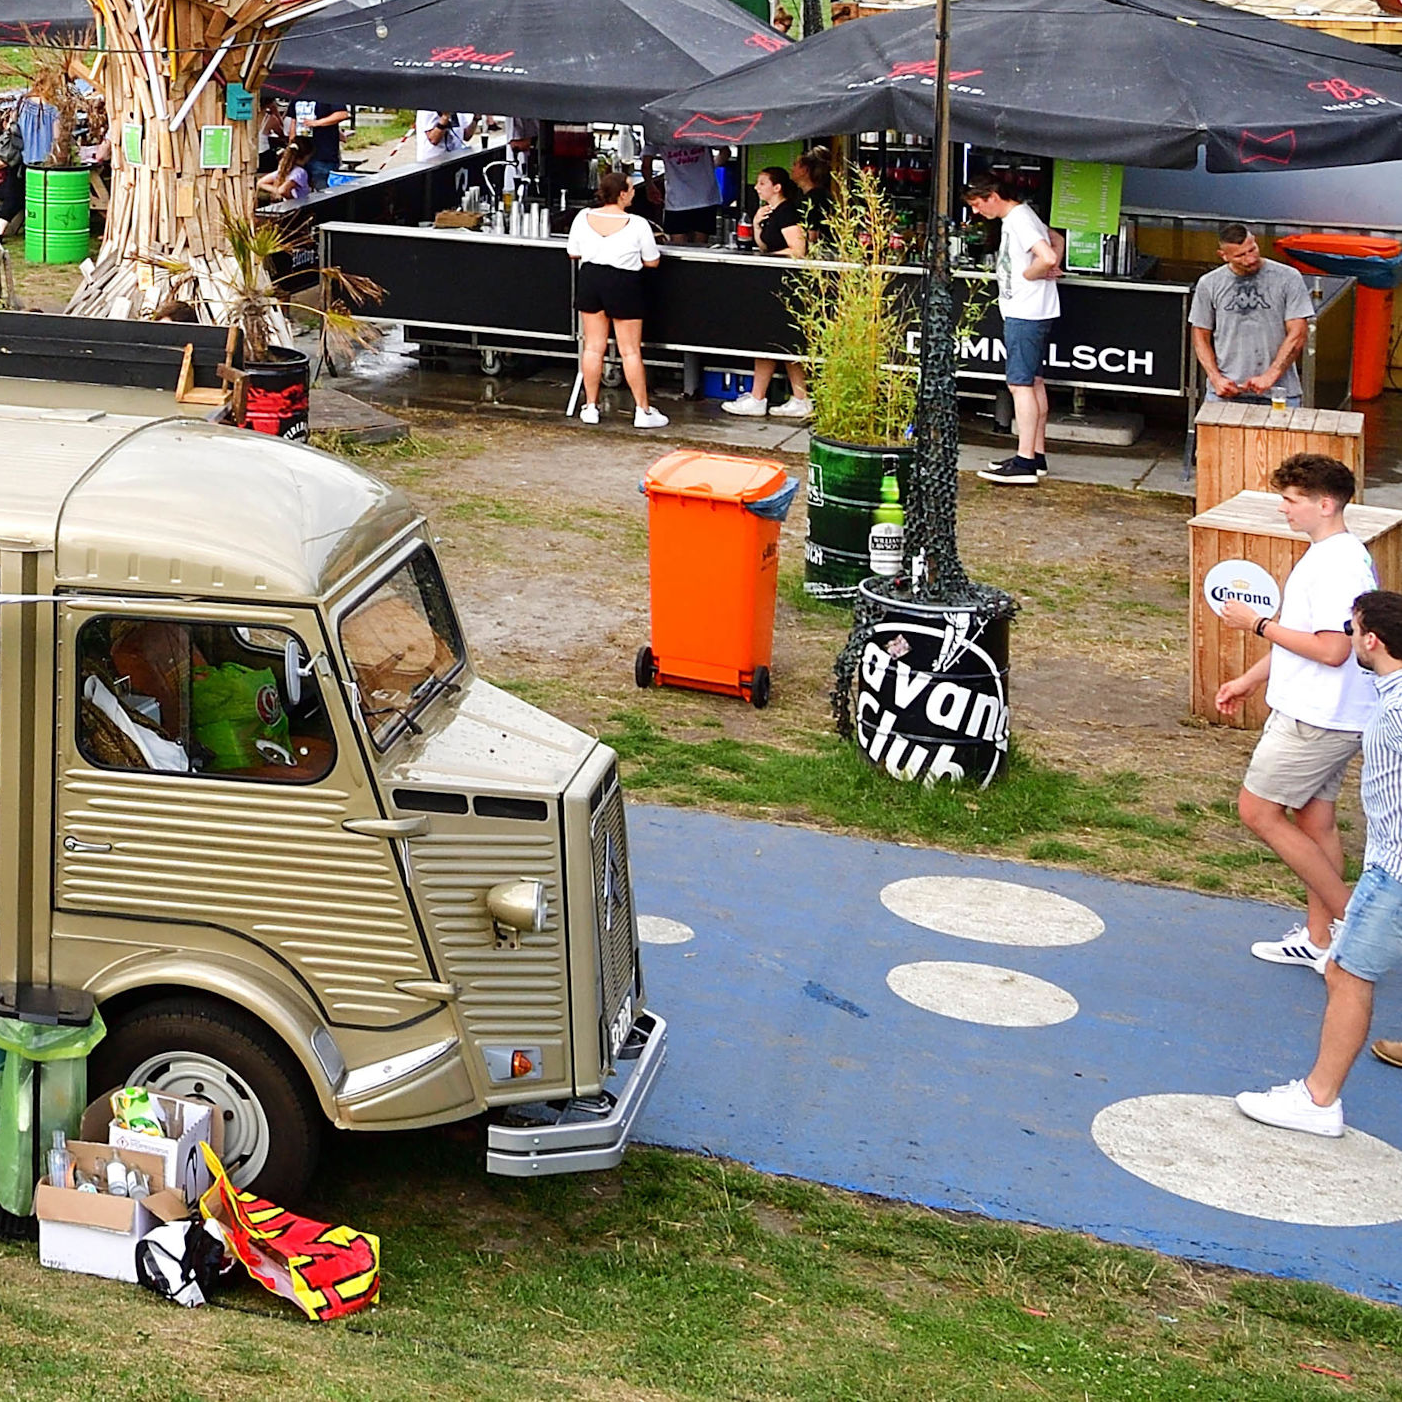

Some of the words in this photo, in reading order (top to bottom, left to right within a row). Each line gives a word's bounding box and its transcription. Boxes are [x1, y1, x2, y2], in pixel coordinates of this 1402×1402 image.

[430, 45, 516, 65] Bud
[441, 61, 465, 69] OF
[1211, 586, 1274, 608] Corona
[857, 691, 965, 789] Club
